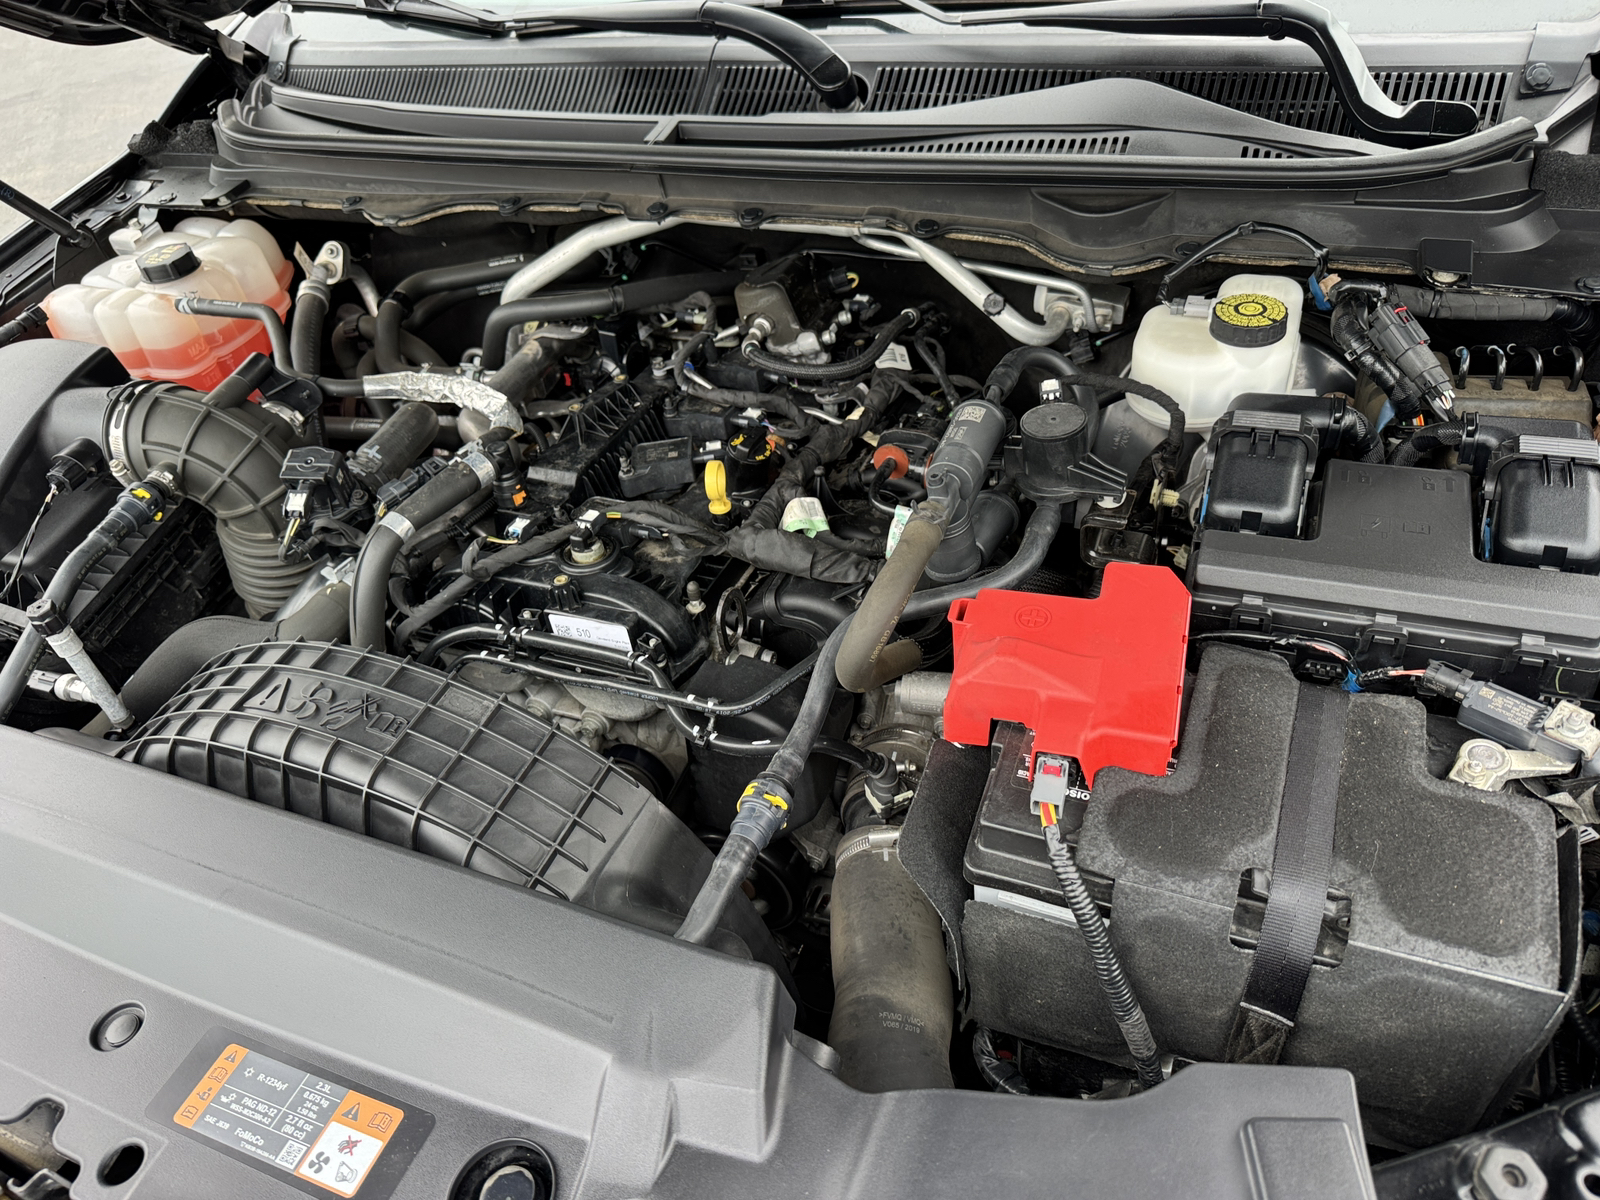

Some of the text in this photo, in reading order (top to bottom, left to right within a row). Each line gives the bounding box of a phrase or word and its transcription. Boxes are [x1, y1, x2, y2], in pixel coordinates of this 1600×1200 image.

[576, 627, 591, 638] 510
[256, 1073, 289, 1091] R-1234yf
[315, 1081, 331, 1094] 2.3L
[241, 1096, 278, 1117] PAG ND-12
[319, 1097, 330, 1108] kg
[203, 1114, 217, 1125] SAE
[285, 1114, 299, 1125] 2.7
[303, 1123, 314, 1132] oz
[234, 1127, 264, 1146] FoMoCo
